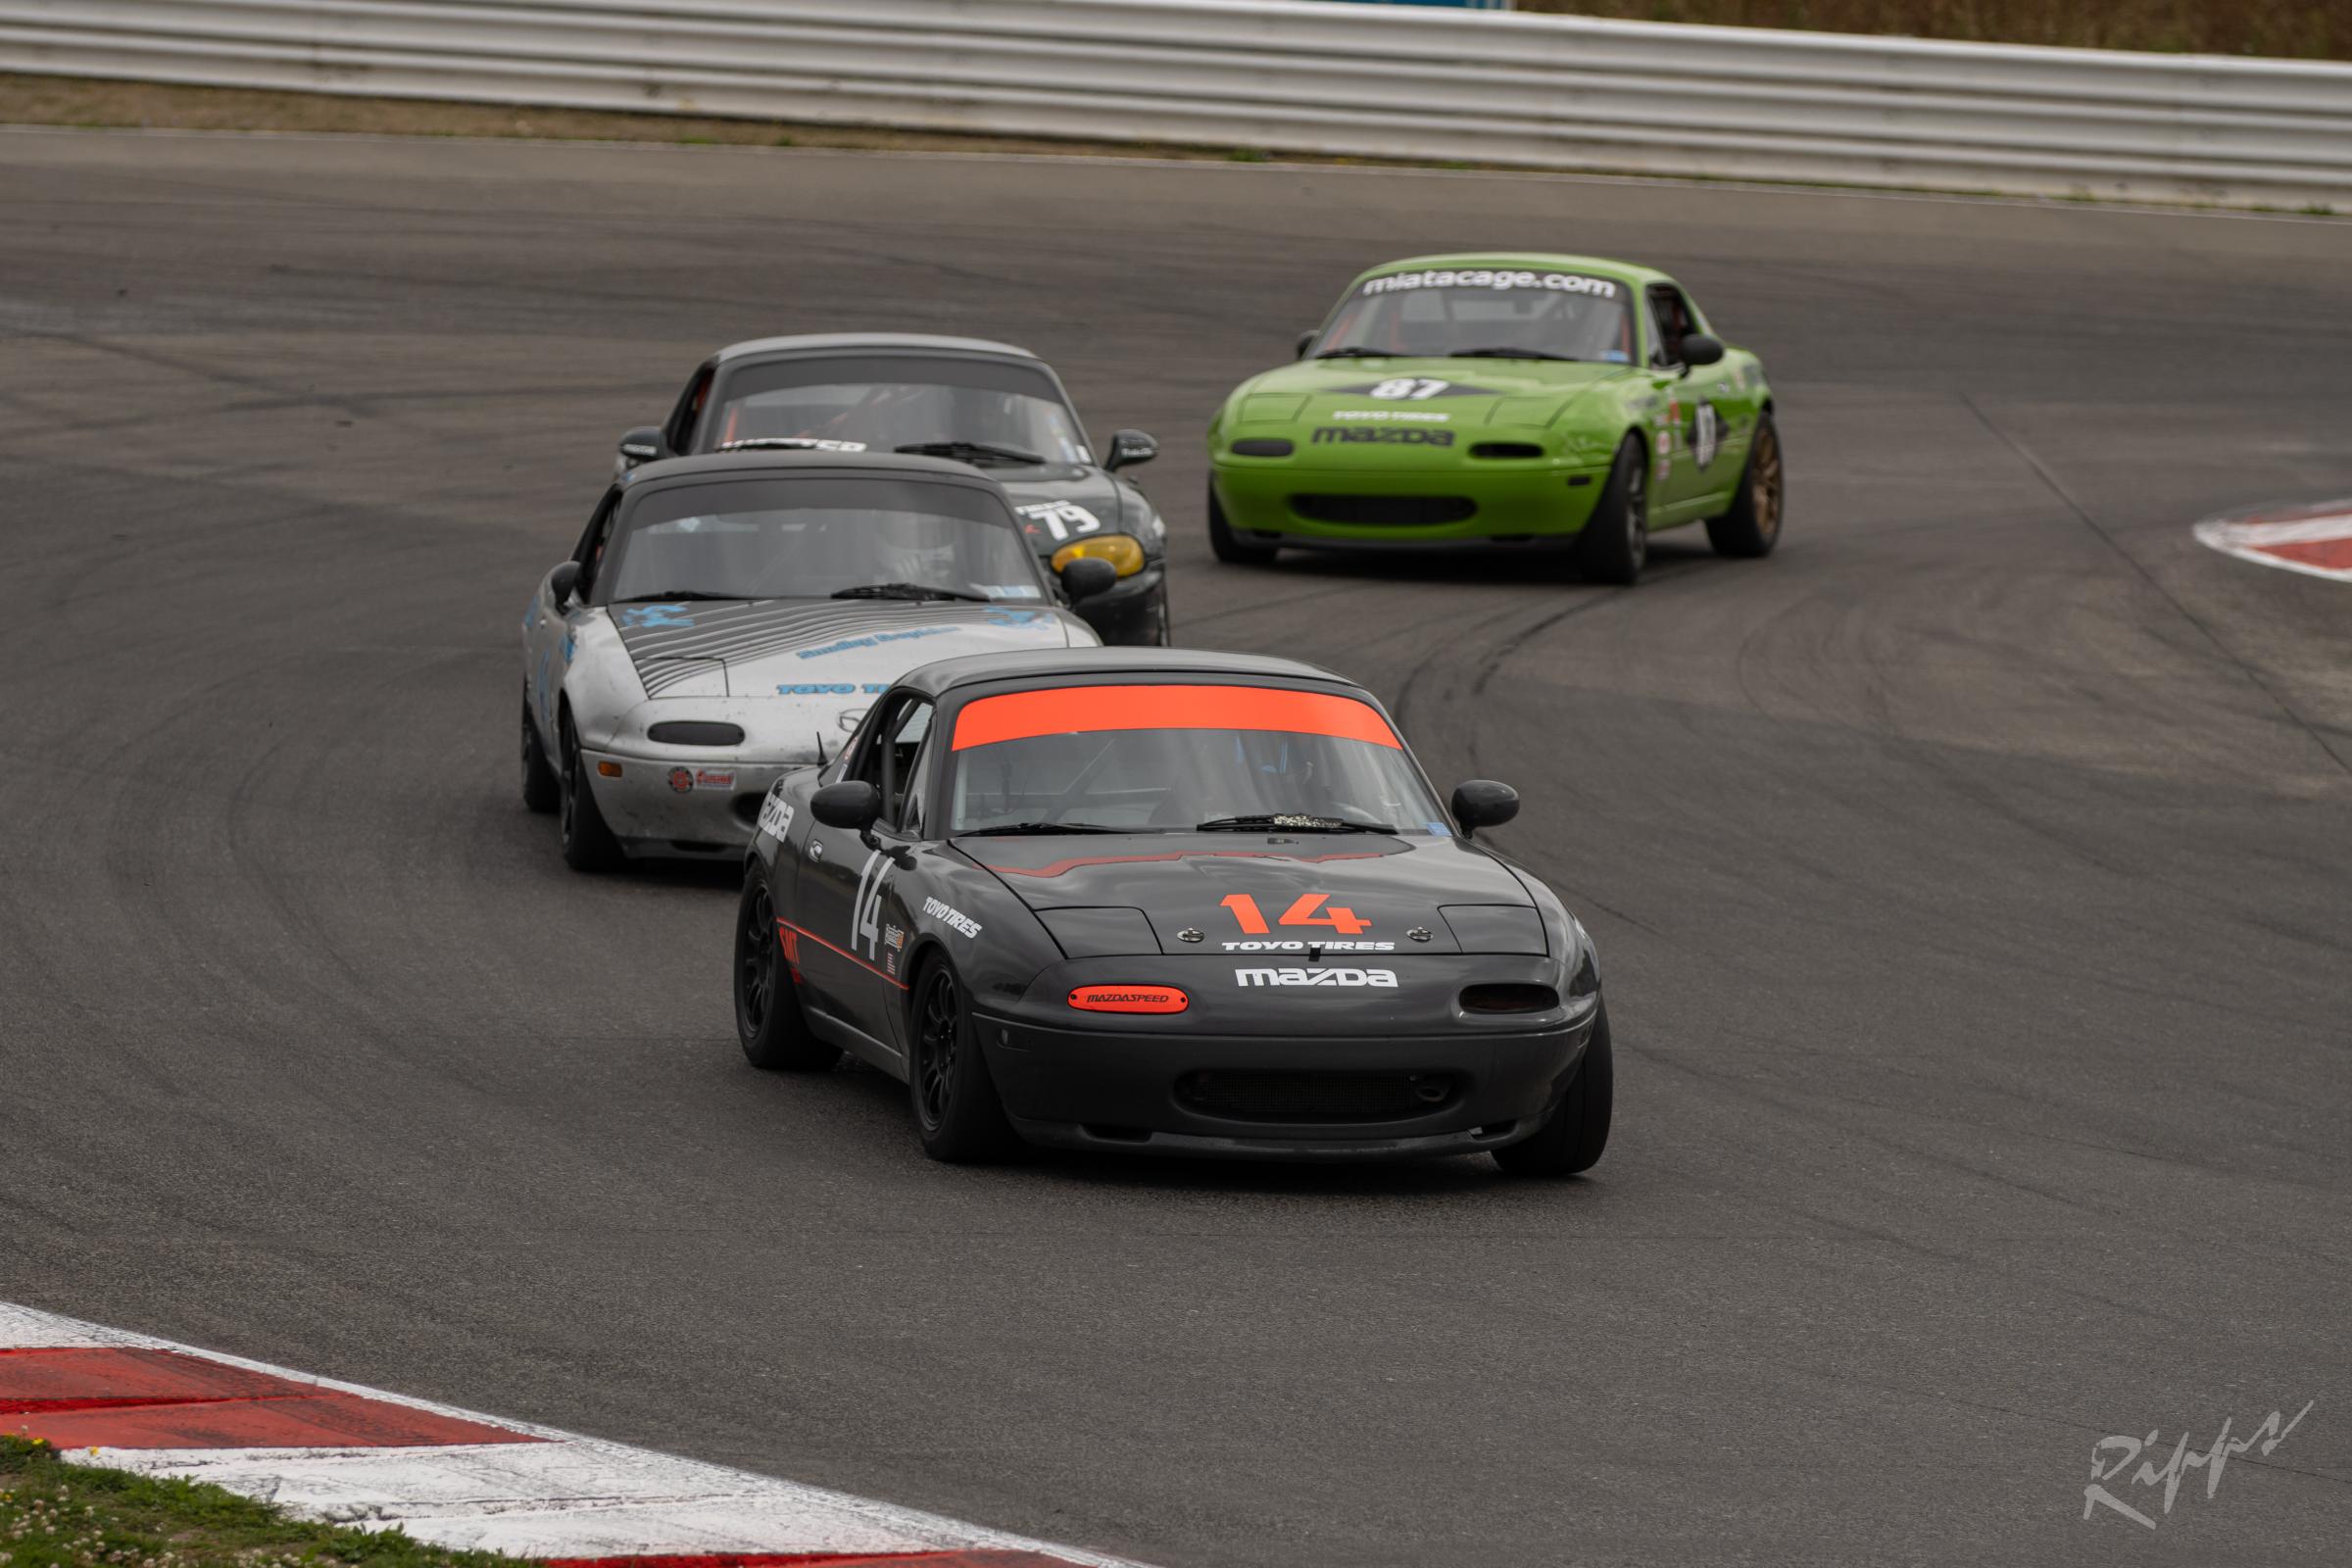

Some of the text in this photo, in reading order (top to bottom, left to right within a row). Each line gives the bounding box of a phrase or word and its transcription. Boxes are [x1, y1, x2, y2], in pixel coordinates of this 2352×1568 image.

[1362, 270, 1616, 298] miatacage.com
[1370, 378, 1450, 401] 87
[1029, 504, 1101, 541] 79
[776, 683, 857, 695] TOYO
[851, 849, 896, 961] 14
[922, 896, 983, 939] TOYO TIRES
[1219, 893, 1372, 935] 14
[1221, 941, 1396, 951] TOYO TIRES
[1086, 994, 1170, 1004] MAZDASPEED
